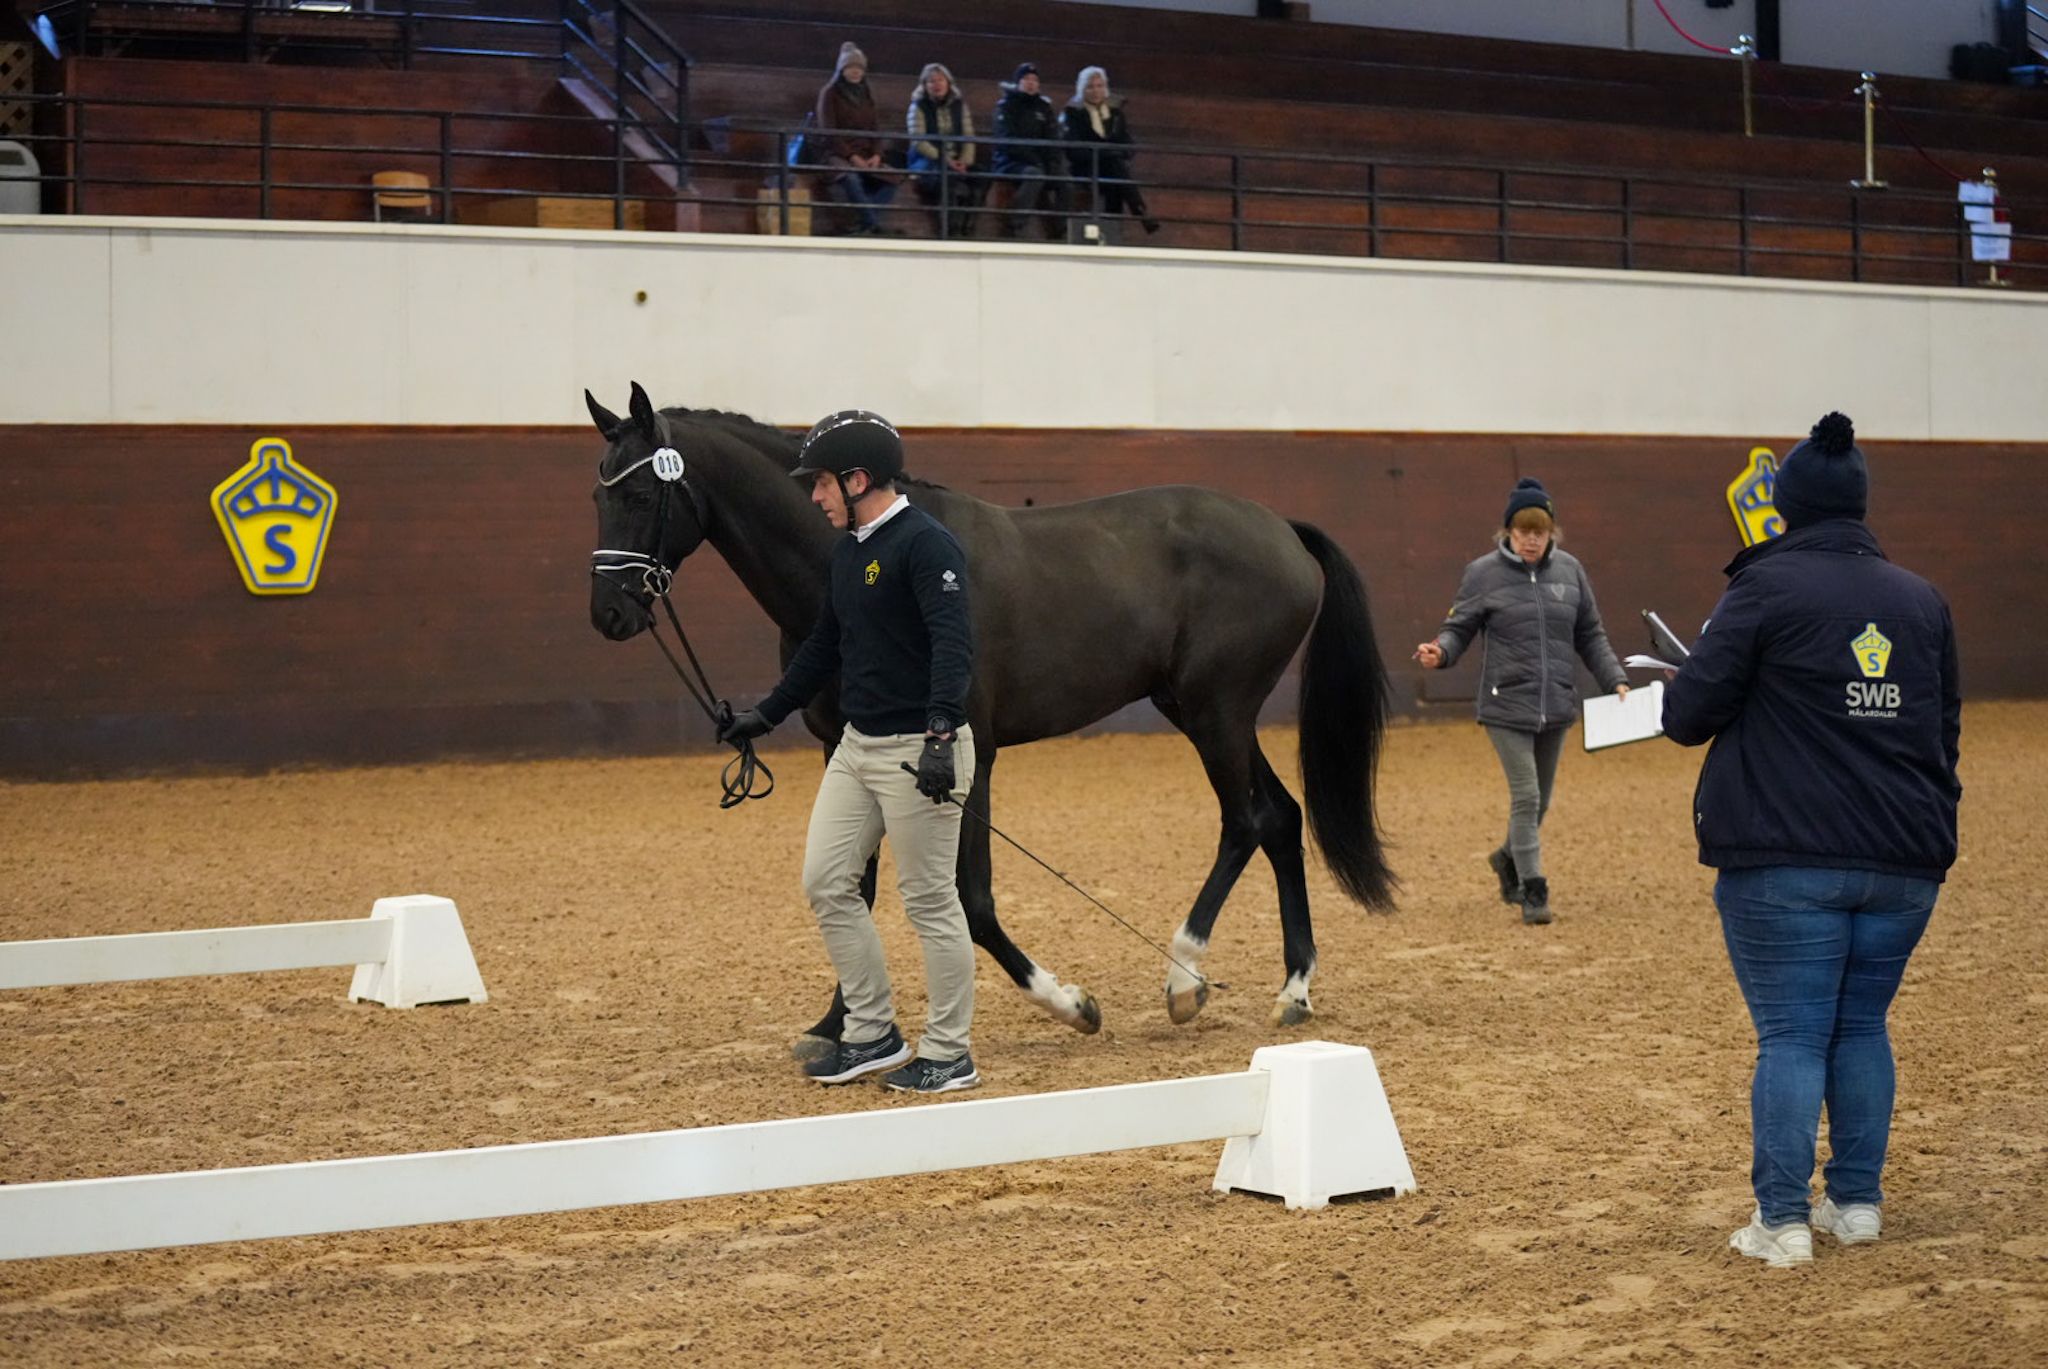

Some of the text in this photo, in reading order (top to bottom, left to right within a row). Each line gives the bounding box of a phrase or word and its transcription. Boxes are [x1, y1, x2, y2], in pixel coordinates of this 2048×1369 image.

[658, 455, 680, 473] 018
[264, 524, 297, 575] S
[1867, 652, 1880, 672] S
[1845, 681, 1901, 708] SWB
